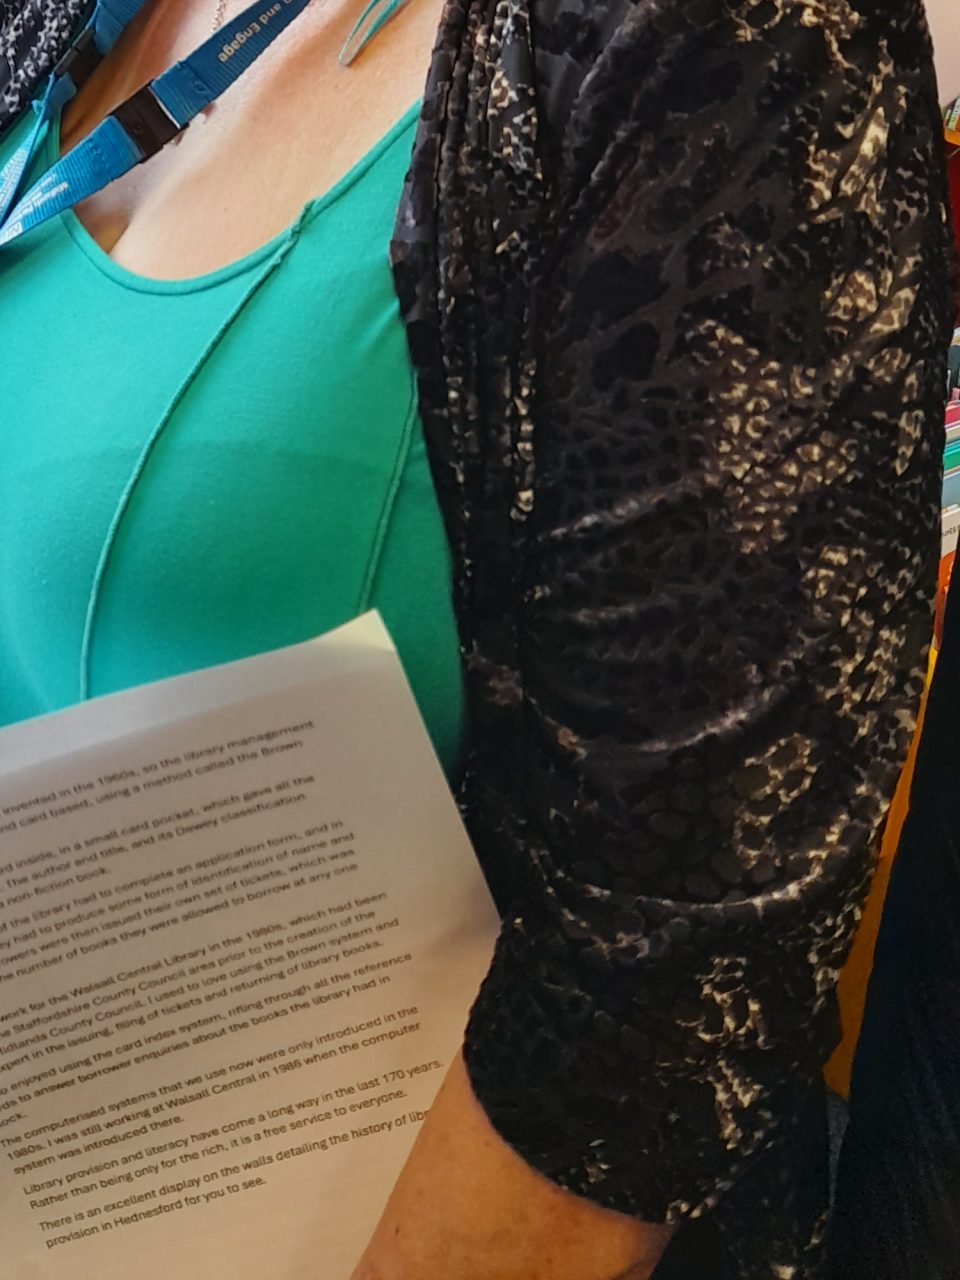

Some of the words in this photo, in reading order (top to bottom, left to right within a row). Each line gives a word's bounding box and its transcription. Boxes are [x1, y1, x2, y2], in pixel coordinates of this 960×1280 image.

[217, 21, 262, 63] Engage
[259, 2, 283, 25] and
[0, 1135, 22, 1147] The
[23, 1105, 106, 1139] computerised
[107, 1090, 157, 1111] systems
[157, 1081, 183, 1095] that
[184, 1075, 203, 1086] we
[204, 1067, 226, 1080] use
[228, 1059, 254, 1072] now
[255, 1048, 285, 1063] were
[287, 1040, 313, 1053] only
[315, 1016, 382, 1044] introduced
[383, 1013, 396, 1022] in
[396, 1006, 418, 1018] the
[7, 1144, 45, 1160] 1980s.
[53, 1131, 78, 1144] was
[79, 1123, 103, 1136] still
[102, 1108, 151, 1129] working
[151, 1103, 165, 1113] at
[164, 1087, 210, 1109] Walsall
[211, 1073, 257, 1094] Central
[257, 1070, 270, 1079] in
[272, 1058, 302, 1074] 1986
[302, 1049, 337, 1065] when
[337, 1042, 359, 1054] the
[360, 1022, 420, 1047] computer
[17, 1093, 32, 1102] to
[33, 1078, 75, 1097] answer
[76, 1059, 131, 1083] borrower
[133, 1040, 190, 1063] enquiries
[191, 1027, 227, 1044] about
[228, 1021, 249, 1032] the
[249, 1008, 288, 1025] books
[289, 1001, 310, 1012] the
[311, 988, 350, 1005] library
[351, 978, 377, 992] had
[378, 975, 390, 984] in
[13, 1155, 56, 1174] system
[56, 1147, 82, 1160] was
[83, 1124, 148, 1152] introduced
[148, 1115, 184, 1130] there.
[22, 1177, 63, 1195] Library
[64, 1159, 119, 1183] provision
[120, 1150, 144, 1164] and
[144, 1137, 188, 1156] literacy
[189, 1128, 219, 1142] have
[220, 1116, 255, 1133] come
[266, 1103, 295, 1119] long
[294, 1096, 319, 1110] way
[320, 1092, 333, 1102] in
[333, 1086, 355, 1097] the
[356, 1077, 380, 1091] last
[382, 1069, 405, 1083] 170
[405, 1060, 443, 1078] years.
[29, 1191, 68, 1209] Rather
[69, 1182, 98, 1196] than
[98, 1171, 134, 1188] being
[133, 1164, 158, 1177] only
[159, 1158, 176, 1168] for
[178, 1151, 199, 1163] the
[200, 1143, 228, 1156] rich,
[230, 1138, 239, 1147] it
[239, 1135, 252, 1144] is
[262, 1124, 287, 1137] free
[288, 1111, 332, 1130] service
[332, 1106, 347, 1116] to
[348, 1089, 407, 1112] everyone.
[38, 1215, 72, 1231] There
[73, 1212, 84, 1221] is
[86, 1207, 102, 1217] an
[103, 1189, 157, 1212] excellent
[158, 1177, 200, 1195] display
[202, 1171, 219, 1182] on
[219, 1165, 240, 1177] the
[241, 1155, 274, 1170] walls
[275, 1138, 328, 1161] detailing
[327, 1132, 349, 1145] the
[350, 1120, 392, 1139] history
[394, 1114, 406, 1126] of
[45, 1225, 99, 1249] provision
[100, 1221, 112, 1231] in
[112, 1198, 183, 1227] Hednesford
[183, 1194, 200, 1206] for
[201, 1188, 225, 1203] you
[225, 1183, 240, 1193] to
[241, 1177, 266, 1189] see.
